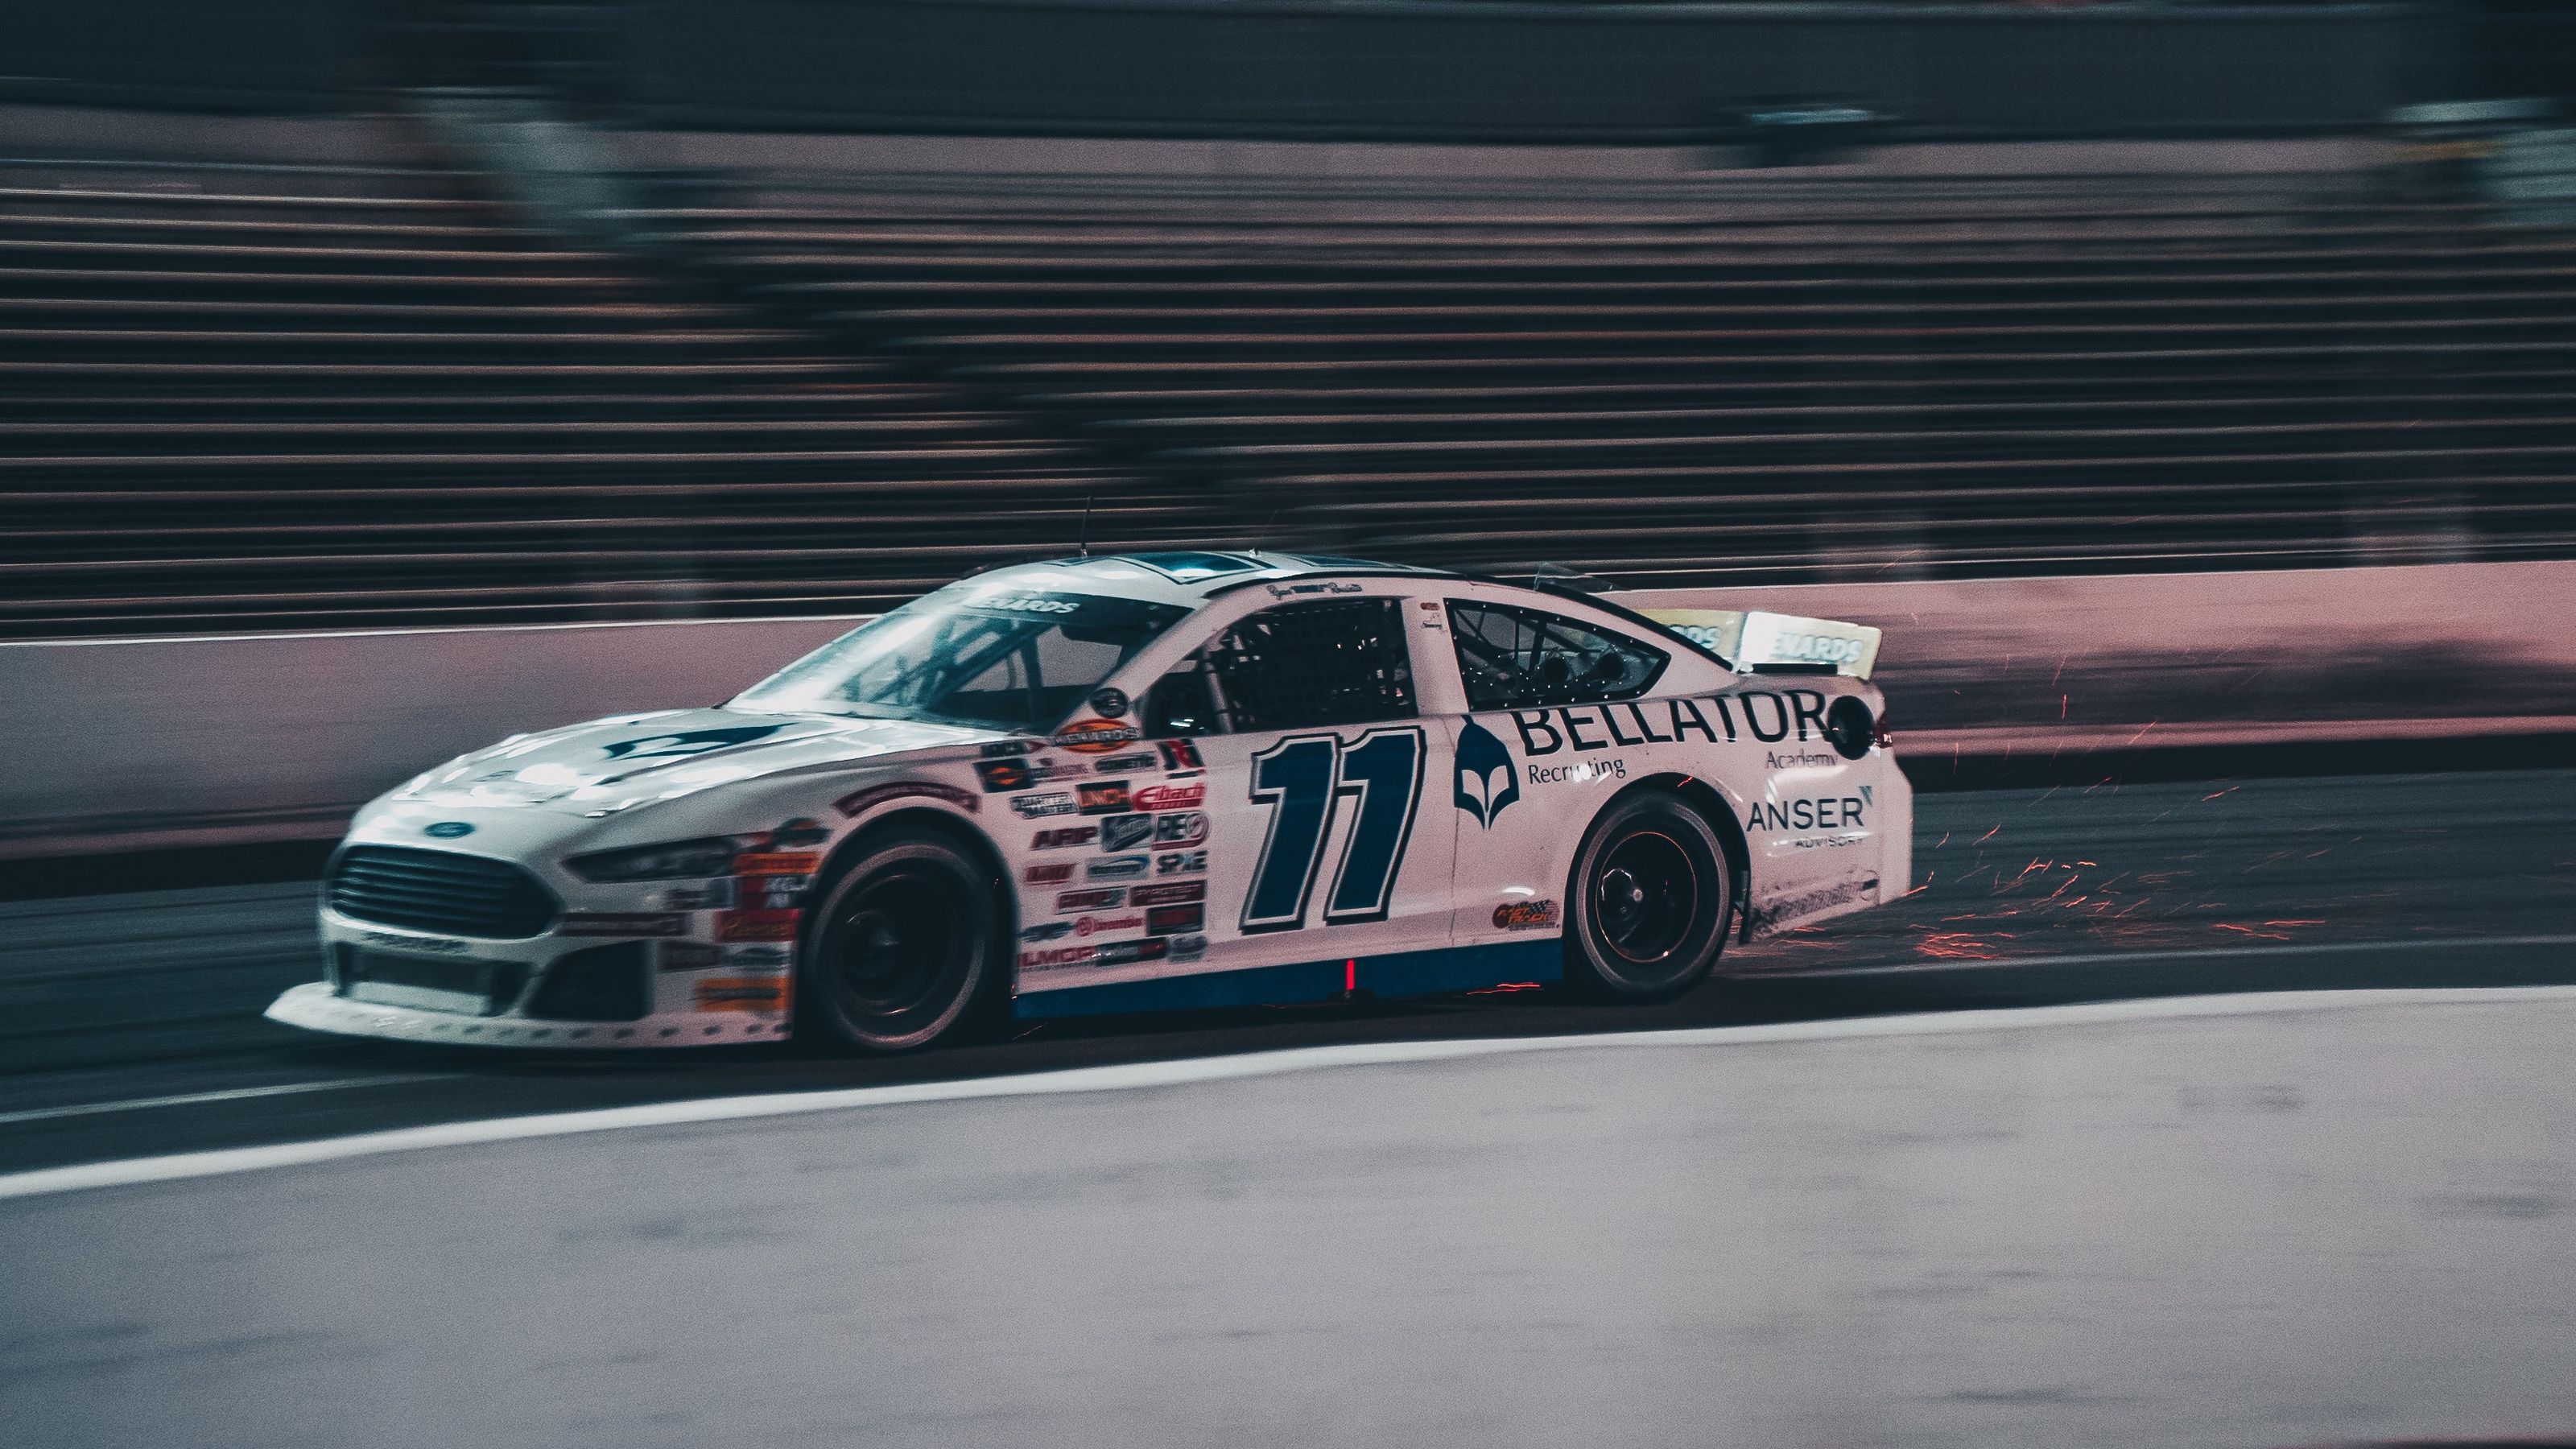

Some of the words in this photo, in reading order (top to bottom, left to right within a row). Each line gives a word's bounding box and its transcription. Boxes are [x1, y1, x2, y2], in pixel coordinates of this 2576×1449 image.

[1509, 690, 1834, 757] BELLATOR
[1529, 758, 1626, 784] Recrting
[1765, 741, 1839, 769] Academy
[1238, 725, 1427, 935] 11
[1746, 798, 1864, 832] ANSER
